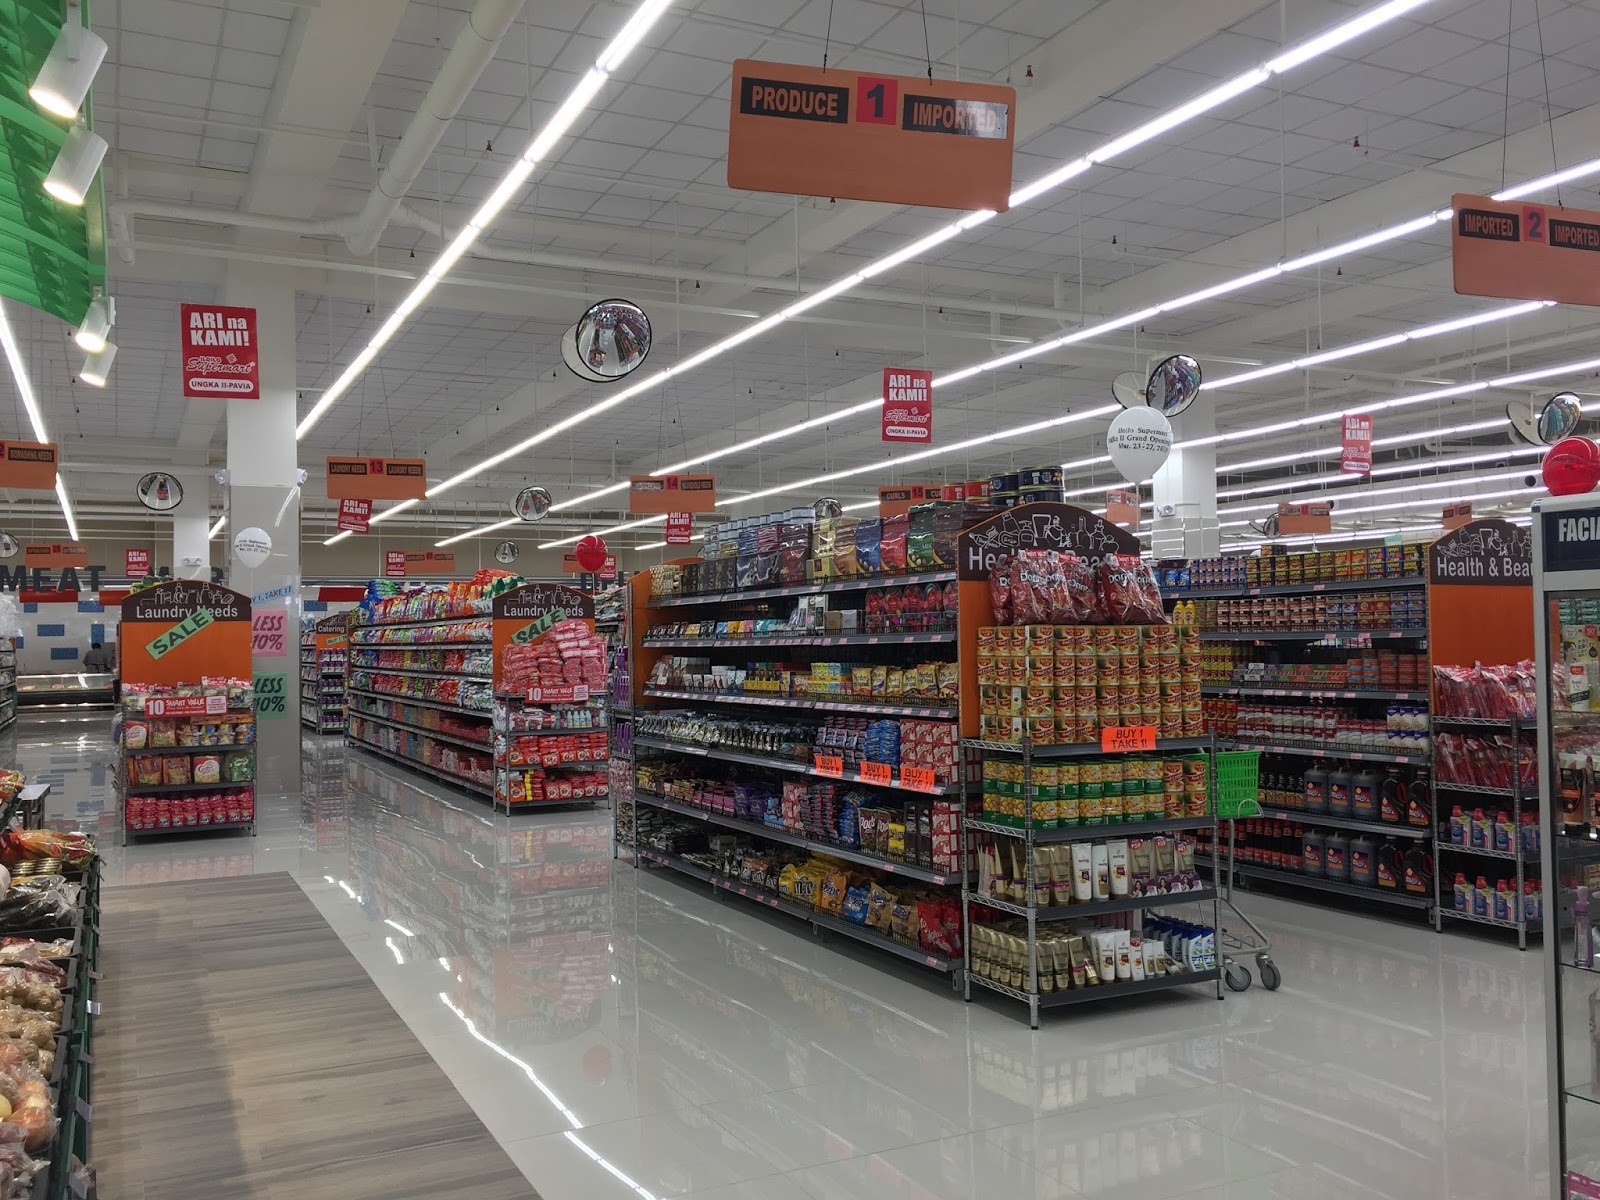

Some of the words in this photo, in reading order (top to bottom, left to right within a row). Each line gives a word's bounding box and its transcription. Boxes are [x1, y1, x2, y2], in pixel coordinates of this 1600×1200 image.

[752, 85, 838, 116] PRODUCE
[866, 83, 885, 118] 1
[912, 102, 996, 132] IMPORTED
[1465, 214, 1513, 237] IMPORTED
[1528, 212, 1542, 238] 2
[1555, 224, 1600, 246] IMPORTED
[190, 312, 223, 329] ARI
[227, 317, 247, 329] na
[190, 329, 250, 346] KAMI!
[186, 357, 255, 375] Supermart
[889, 374, 910, 388] ARI
[913, 378, 927, 388] na
[888, 388, 927, 402] KAMI!
[1126, 434, 1147, 442] Grand
[330, 464, 350, 473] LAUNDRY
[370, 461, 383, 472] 13
[666, 478, 678, 488] 14
[886, 492, 905, 500] CURLS
[913, 487, 923, 497] 15
[1437, 556, 1484, 577] Health
[1489, 557, 1499, 577] &
[1503, 557, 1533, 577] Bea
[0, 565, 106, 592] MEAT
[264, 588, 283, 599] TAKE
[136, 605, 192, 619] Laundry
[503, 604, 548, 617] Laundry
[252, 615, 284, 631] LESS
[318, 625, 345, 633] Catering
[516, 609, 563, 643] SALE
[152, 611, 209, 655] SALE
[252, 633, 283, 650] 10%
[254, 677, 283, 694] LESS
[527, 687, 542, 701] 10
[146, 700, 164, 715] 10
[255, 696, 285, 712] 10%
[1116, 729, 1137, 739] BUY
[1139, 729, 1144, 738] 1
[1111, 739, 1138, 749] TAKE
[821, 757, 833, 765] BUY
[866, 763, 880, 772] BUY
[864, 771, 882, 782] TAKE
[904, 768, 923, 779] BUY
[902, 777, 922, 789] TAKE
